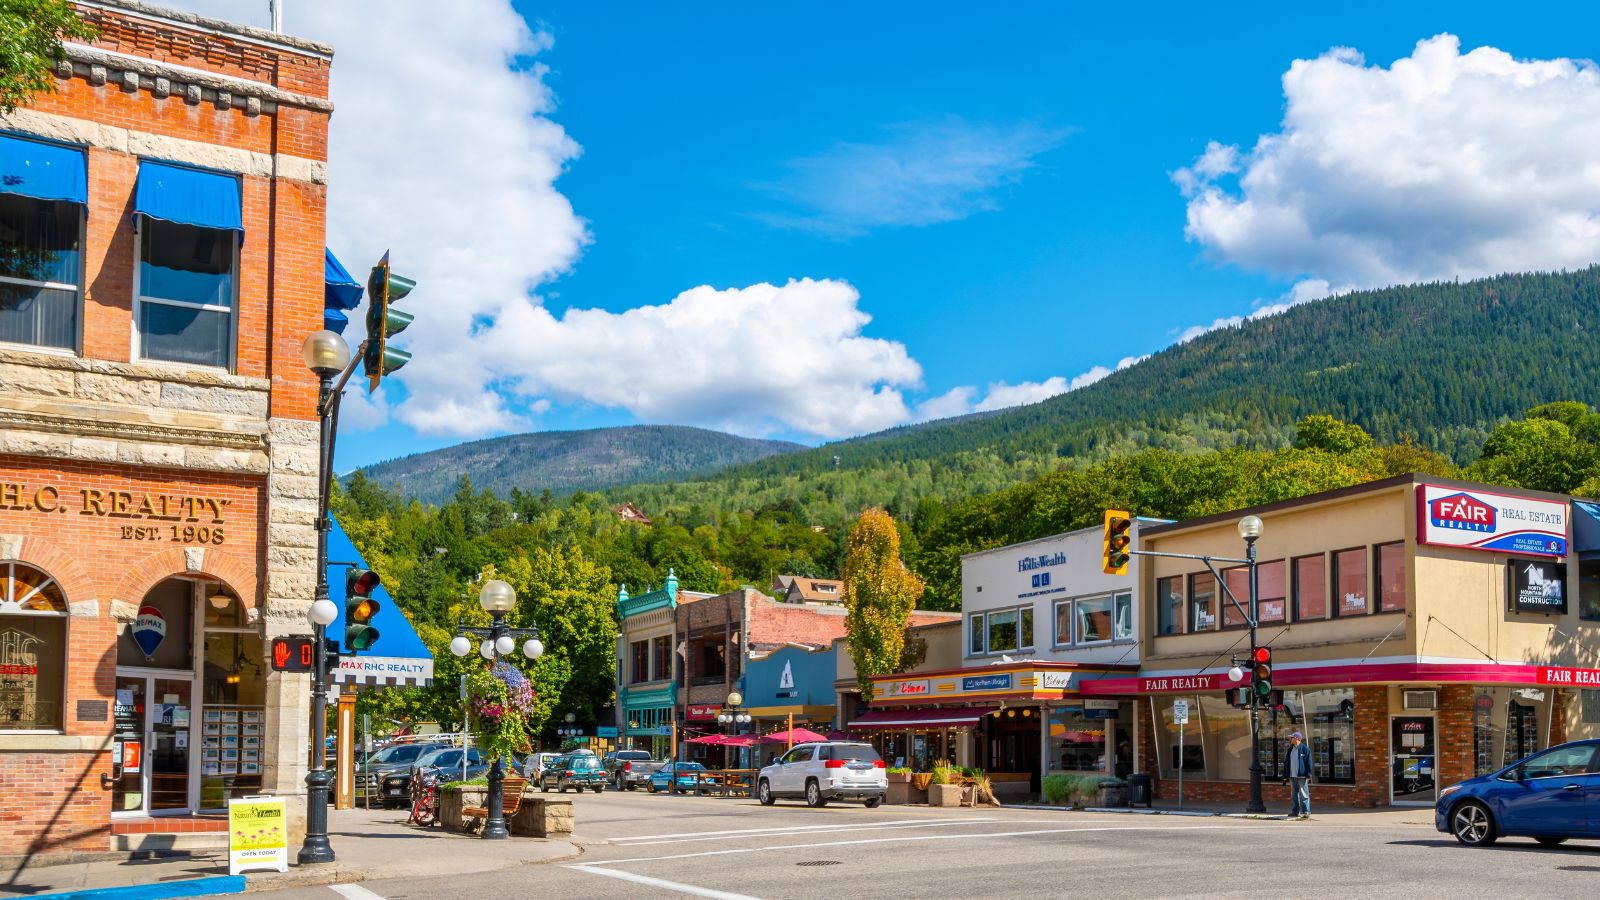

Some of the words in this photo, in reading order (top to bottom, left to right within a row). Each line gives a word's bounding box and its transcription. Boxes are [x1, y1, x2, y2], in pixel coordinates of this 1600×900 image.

[80, 488, 231, 524] REALTY
[1440, 501, 1488, 522] FAIR
[1502, 507, 1527, 521] REAL
[1529, 511, 1562, 525] ESTATE
[1440, 519, 1488, 532] REALTY
[120, 525, 162, 541] EST.
[170, 525, 225, 545] 1908
[1017, 551, 1067, 573] HollisWealth
[1519, 596, 1563, 606] CONSTRUCTION
[135, 618, 162, 630] RE/MAX
[364, 662, 385, 672] RHC
[387, 663, 425, 673] REALTY
[1145, 679, 1169, 690] FAIR
[1172, 676, 1212, 690] REALTY
[1546, 669, 1572, 683] FAIR
